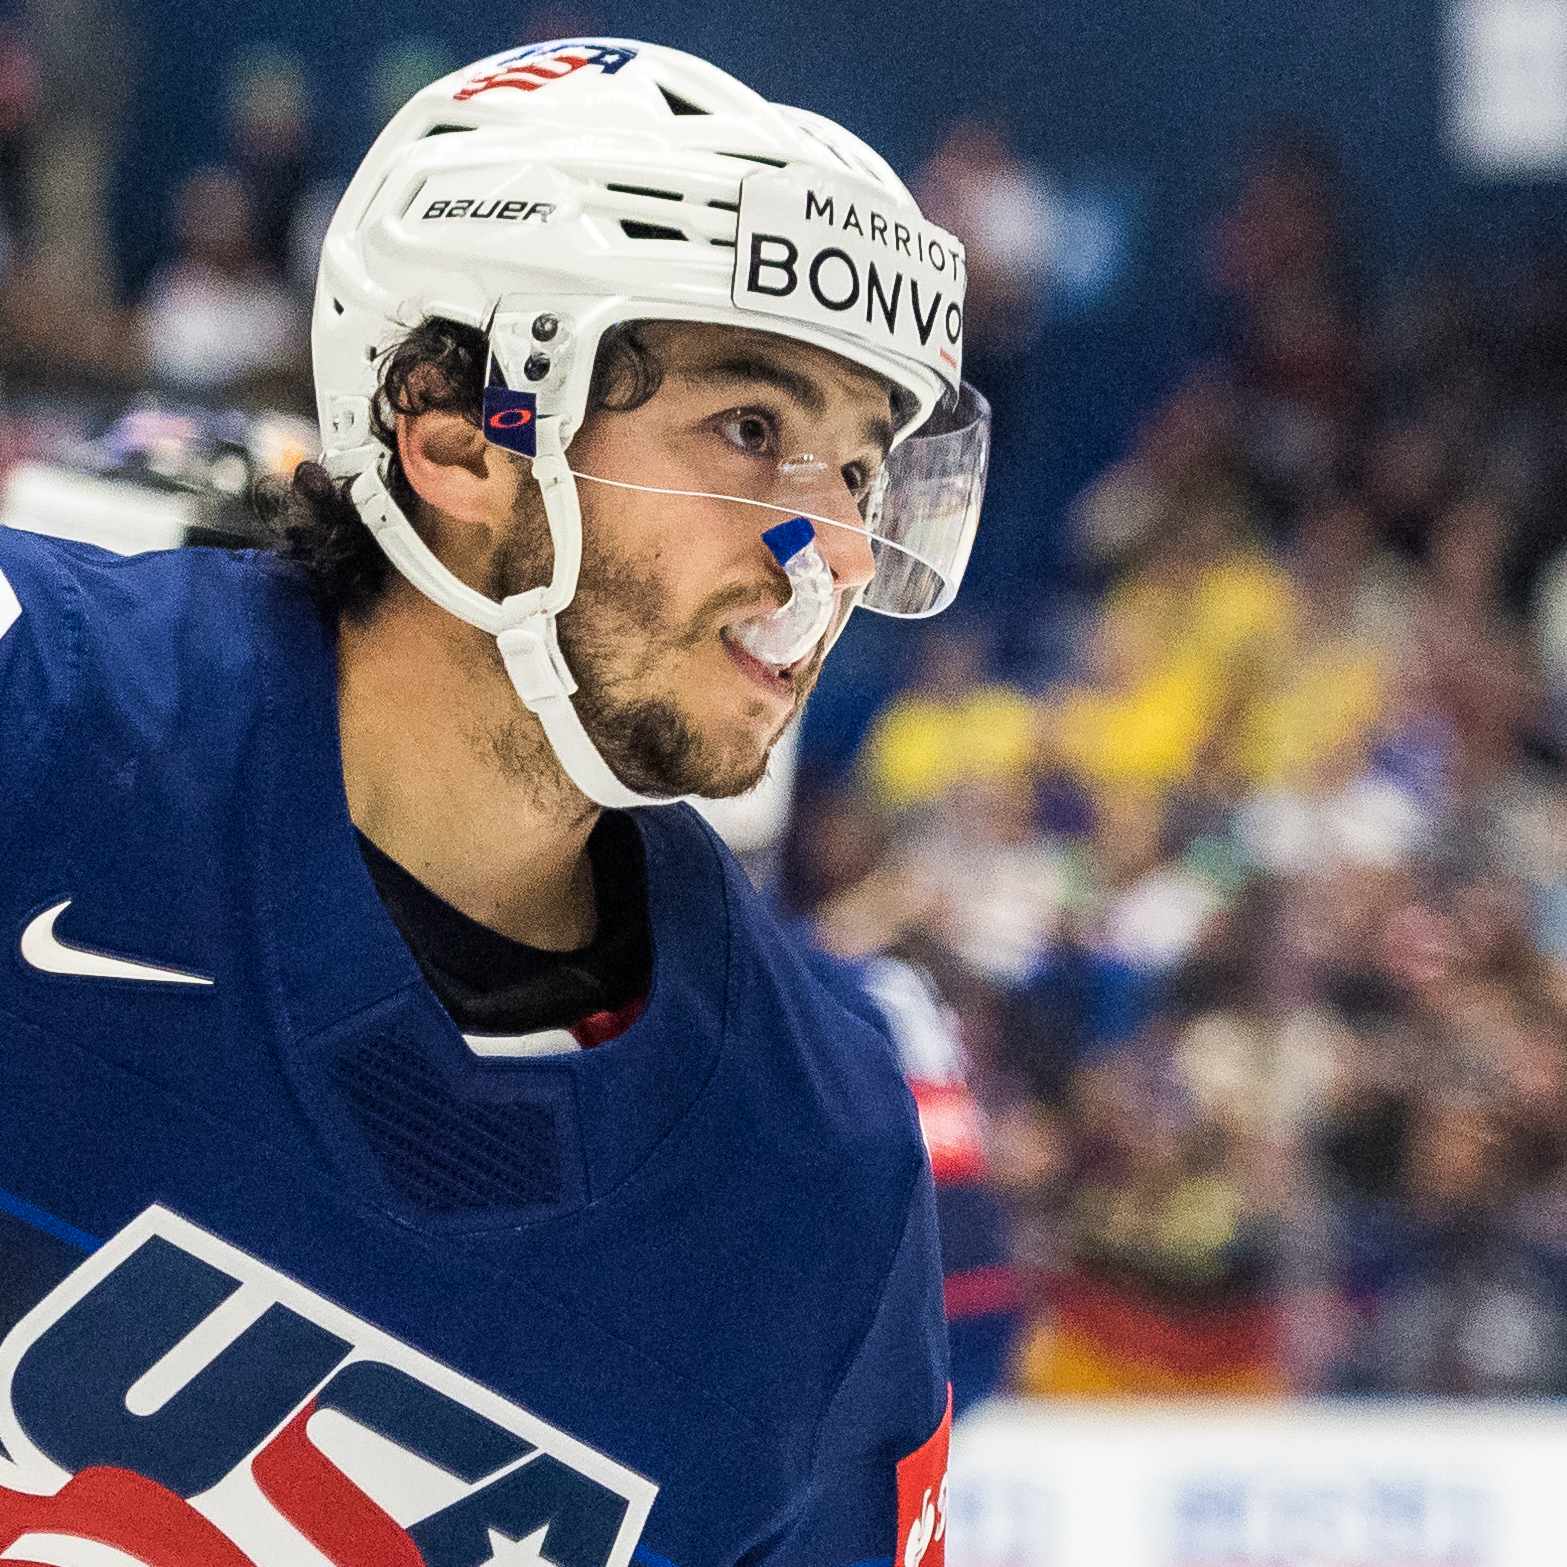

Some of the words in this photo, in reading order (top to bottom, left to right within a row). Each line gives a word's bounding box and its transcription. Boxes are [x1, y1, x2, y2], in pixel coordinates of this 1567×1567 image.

[422, 199, 557, 223] BAUER
[803, 190, 965, 281] MARRIOT
[746, 232, 962, 346] BONVO
